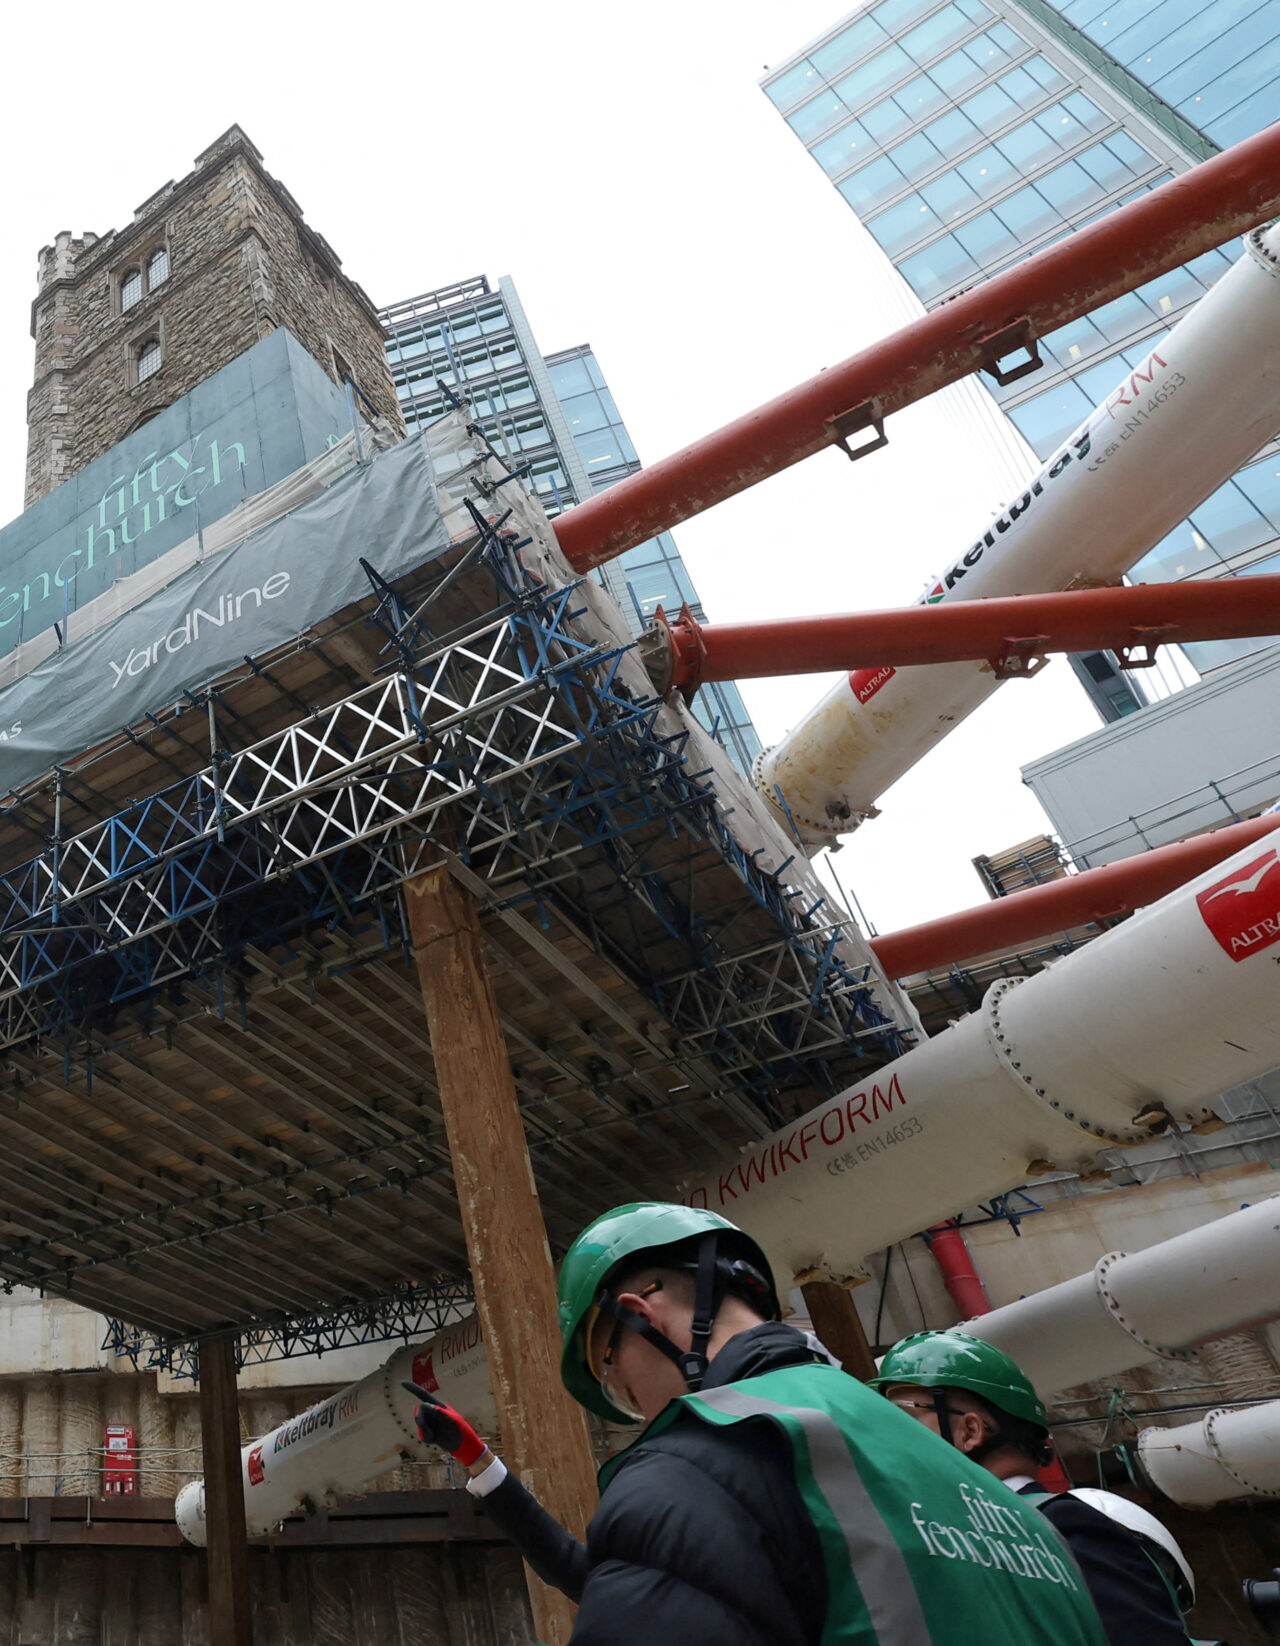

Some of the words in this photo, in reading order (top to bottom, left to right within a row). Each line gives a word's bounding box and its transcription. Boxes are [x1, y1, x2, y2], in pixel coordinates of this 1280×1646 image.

[97, 433, 202, 529] fifty
[108, 571, 291, 689] YardNine
[719, 1072, 907, 1206] KWIKFORM
[855, 1116, 924, 1162] EN14653
[283, 1402, 338, 1449] keltbray
[910, 1502, 1079, 1592] fenchurch
[958, 1483, 1035, 1546] fifty
